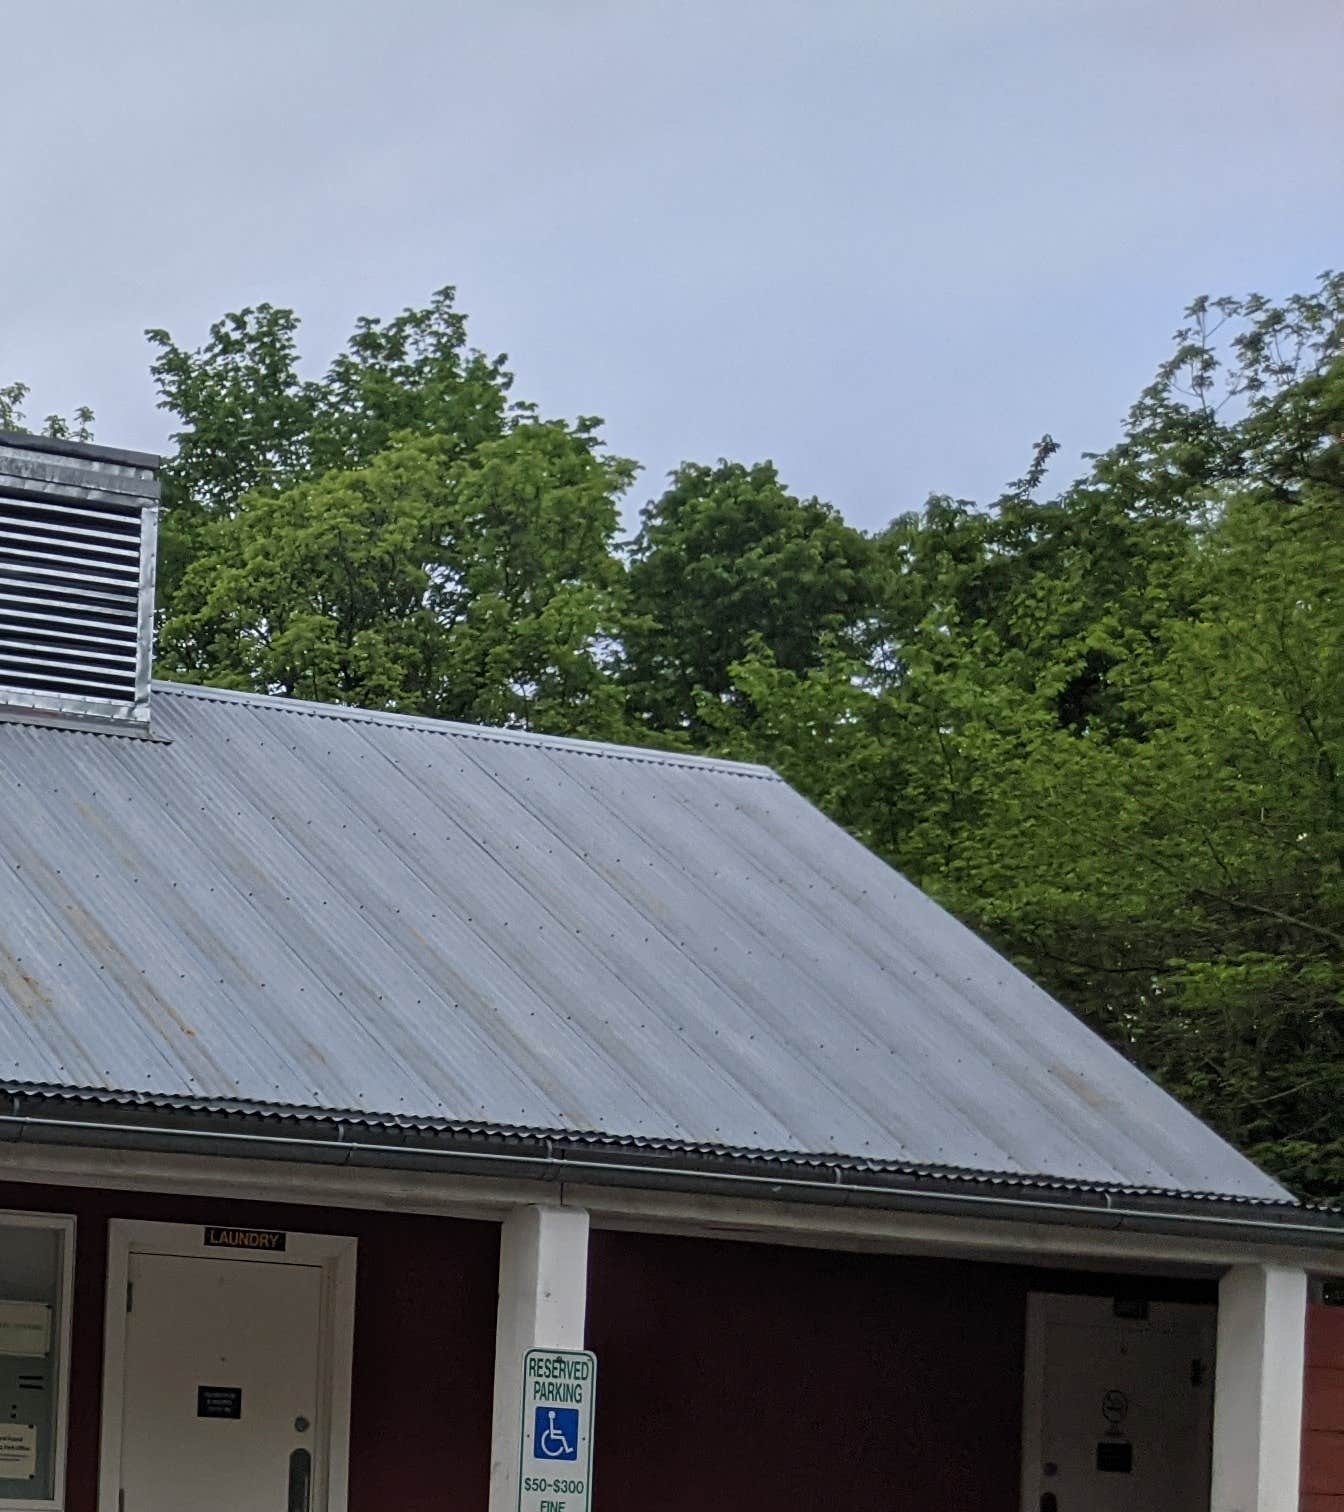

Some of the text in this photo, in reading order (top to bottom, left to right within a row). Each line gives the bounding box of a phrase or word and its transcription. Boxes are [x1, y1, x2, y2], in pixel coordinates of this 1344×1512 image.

[210, 1229, 279, 1247] LAUNDRY
[529, 1357, 590, 1380] RESERVED
[534, 1381, 582, 1404] PARKING
[524, 1477, 584, 1494] $50-$300
